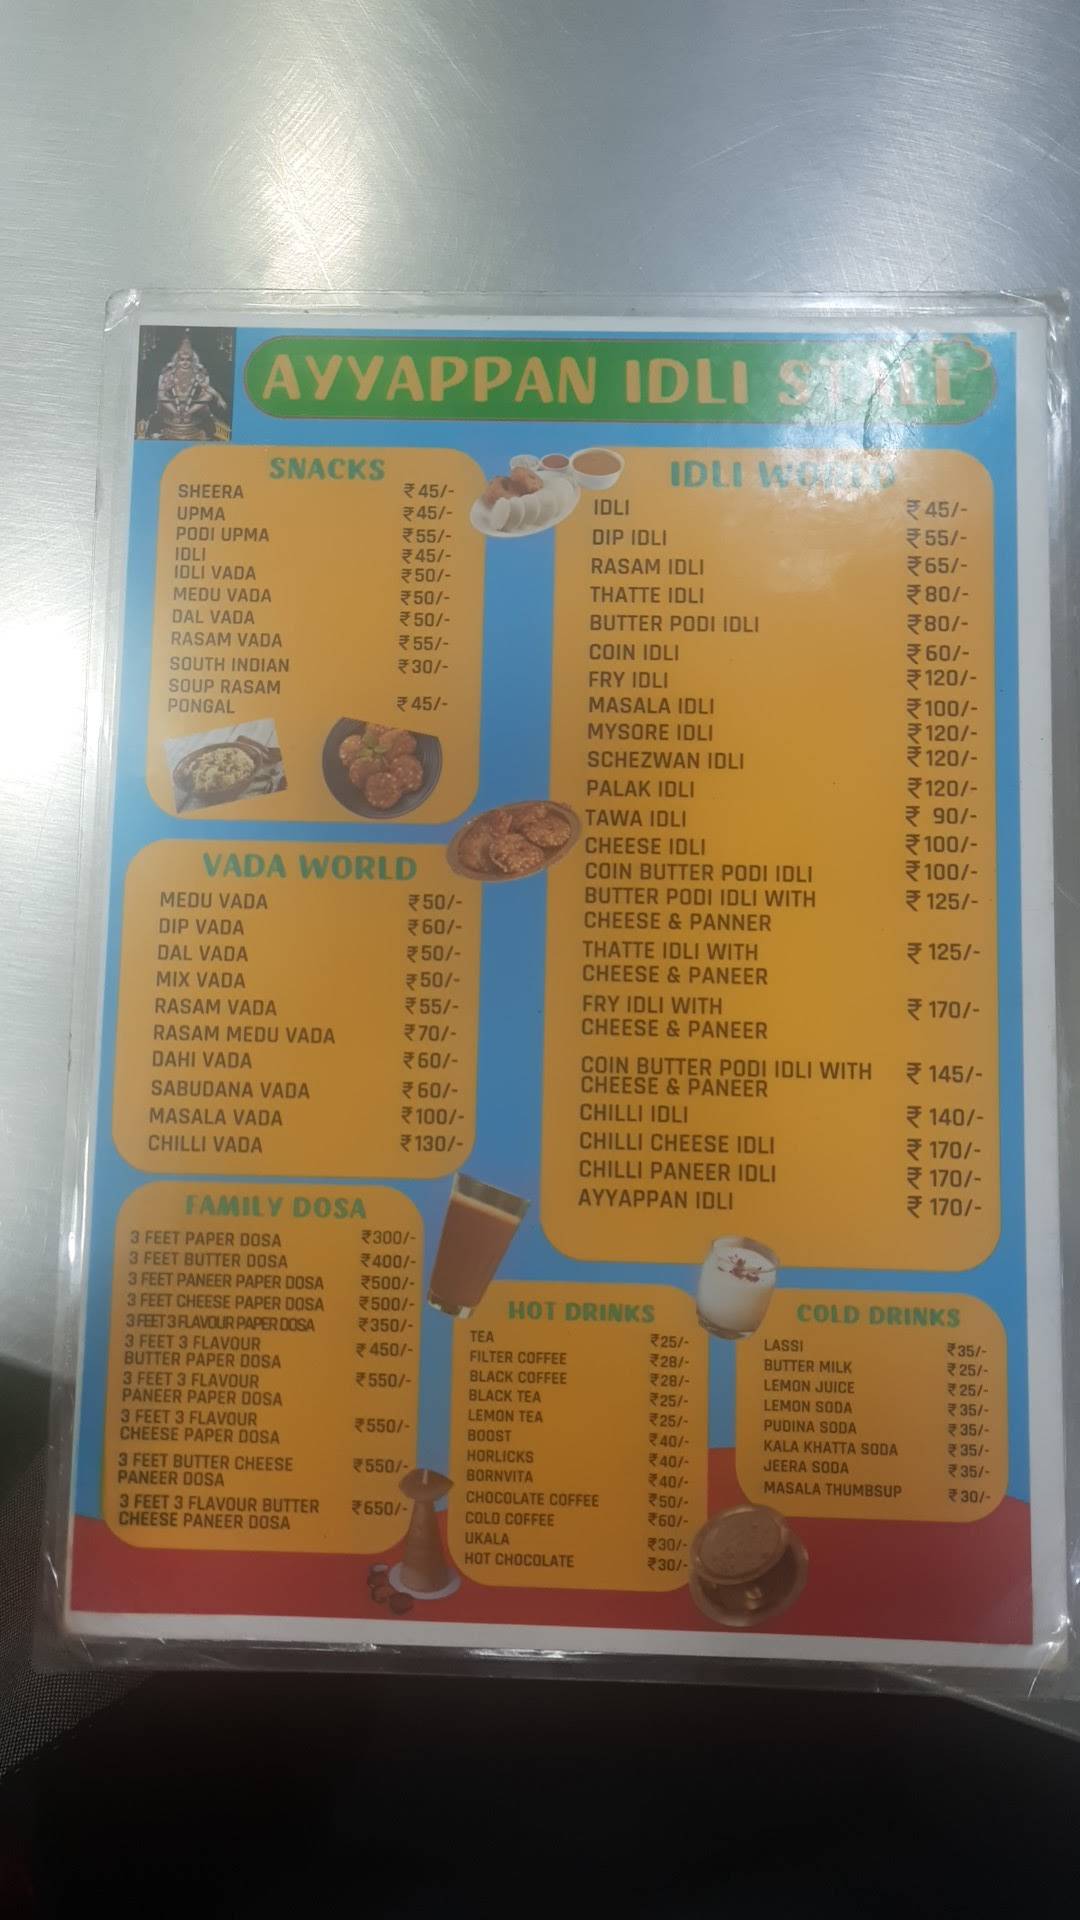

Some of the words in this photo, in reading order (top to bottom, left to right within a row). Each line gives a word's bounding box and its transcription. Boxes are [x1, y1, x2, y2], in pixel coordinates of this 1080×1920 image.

[262, 353, 597, 405] AYYAPPAN
[625, 358, 748, 405] IDLI
[270, 457, 384, 480] SNACKS
[670, 460, 742, 487] IDLI
[178, 483, 244, 498] SHEERA
[177, 506, 225, 520] UPMA
[594, 498, 629, 515] IDLI
[176, 526, 214, 541] PODI
[221, 527, 269, 541] UPMA
[592, 528, 624, 545] DIP
[631, 529, 666, 546] IDLI
[175, 546, 206, 561] IDLI
[174, 564, 204, 579] IDLI
[211, 565, 256, 580] VADA
[591, 557, 660, 574] RASAM
[668, 558, 704, 575] IDLI
[173, 586, 221, 601] MEDU
[226, 587, 272, 602] VADA
[589, 586, 660, 603] THATTE
[668, 587, 704, 603] IDLI
[172, 608, 203, 623] DAL
[210, 609, 255, 624] VADA
[590, 614, 662, 631] BUTTER
[670, 615, 715, 632] PODI
[723, 615, 758, 632] IDLI
[171, 631, 231, 646] RASAM
[237, 632, 282, 647] VADA
[589, 643, 635, 660] COIN
[643, 644, 679, 661] IDLI
[170, 656, 225, 671] SOUTH
[231, 657, 289, 672] INDIAN
[168, 678, 214, 693] SOUP
[220, 679, 280, 694] RASAM
[589, 671, 625, 687] FRY
[632, 671, 668, 688] IDLI
[168, 698, 235, 714] PONGAL
[589, 696, 671, 714] MASALA
[678, 697, 714, 714] IDLI
[588, 723, 669, 740] MYSORE
[677, 724, 712, 741] IDLI
[587, 751, 699, 768] SCHEZWAN
[708, 752, 743, 769] IDLI
[587, 779, 650, 797] PALAK
[658, 780, 694, 798] IDLI
[585, 809, 642, 826] TAWA
[650, 810, 686, 827] IDLI
[585, 837, 661, 854] CHEESE
[669, 838, 705, 855] IDLI
[202, 853, 286, 878] VADA
[298, 855, 417, 880] WORLD
[160, 891, 212, 908] MEDU
[218, 893, 268, 909] VADA
[159, 918, 189, 934] DIP
[195, 919, 244, 935] VADA
[157, 944, 192, 961] DAL
[199, 945, 248, 962] VADA
[156, 971, 190, 987] MIX
[196, 972, 245, 988] VADA
[155, 997, 221, 1014] RASAM
[227, 999, 277, 1016] VADA
[153, 1024, 219, 1041] RASAM
[226, 1026, 278, 1042] MEDU
[285, 1027, 335, 1044] VADA
[152, 1050, 195, 1067] DAHI
[202, 1051, 252, 1068] VADA
[151, 1080, 253, 1097] SABUDANA
[260, 1082, 310, 1099] VADA
[149, 1107, 226, 1124] MASALA
[233, 1109, 282, 1126] VADA
[148, 1135, 206, 1152] CHILLI
[213, 1136, 262, 1153] VADA
[579, 1132, 642, 1150] CHILLI
[650, 1134, 728, 1153] CHEESE
[737, 1135, 774, 1154] IDLI
[579, 1160, 642, 1179] CHILLI
[650, 1162, 730, 1181] PANEER
[738, 1164, 775, 1182] IDLI
[185, 1195, 283, 1216] FAMILY
[292, 1196, 367, 1219] DOSA
[578, 1190, 687, 1208] AYYAPPAN
[696, 1192, 733, 1210] IDLI
[130, 1230, 140, 1244] 3
[144, 1230, 180, 1245] FEET
[185, 1231, 234, 1246] PAPER
[239, 1232, 282, 1247] DOSA
[129, 1250, 138, 1264] 3
[144, 1251, 178, 1265] FEET
[184, 1252, 241, 1267] BUTTER
[246, 1253, 288, 1268] DOSA
[128, 1271, 137, 1285] 3
[141, 1271, 173, 1286] FEET
[176, 1272, 232, 1287] PANEER
[235, 1274, 281, 1288] PAPER
[285, 1275, 324, 1290] DOSA
[508, 1301, 554, 1320] HOT
[564, 1302, 655, 1323] DRINKS
[796, 1304, 860, 1324] COLD
[868, 1306, 960, 1327] DRINKS
[470, 1329, 494, 1343] TEA
[764, 1339, 803, 1352] LASSI
[470, 1350, 513, 1363] FILTER
[517, 1351, 566, 1365] COFFEE
[764, 1358, 814, 1372] BUTTER
[819, 1360, 852, 1374] MILK
[469, 1369, 513, 1382] BLACK
[517, 1371, 567, 1384] COFFEE
[764, 1379, 810, 1392] LEMON
[815, 1380, 854, 1394] JUICE
[468, 1388, 512, 1402] BLACK
[517, 1390, 541, 1403] TEA
[764, 1399, 810, 1412] LEMON
[815, 1400, 852, 1414] SODA
[468, 1409, 514, 1422] LEMON
[519, 1410, 543, 1423] TEA
[467, 1428, 511, 1442] BOOST
[764, 1419, 815, 1432] PUDINA
[819, 1421, 857, 1434] SODA
[466, 1449, 534, 1463] HORLICKS
[763, 1439, 799, 1453] KALA
[803, 1441, 856, 1454] KHATTA
[860, 1442, 898, 1456] SODA
[763, 1459, 807, 1472] JEERA
[811, 1460, 849, 1474] SODA
[466, 1469, 533, 1482] BORNVITA
[764, 1481, 821, 1495] MASALA
[825, 1483, 902, 1497] THUMBSUP
[466, 1491, 544, 1505] CHOCOLATE
[549, 1493, 599, 1507] COFFEE
[465, 1511, 500, 1525] COLD
[504, 1512, 554, 1526] COFFEE
[464, 1531, 510, 1545] UKALA
[464, 1551, 491, 1564] HOT
[495, 1553, 574, 1567] CHOCOLATE
